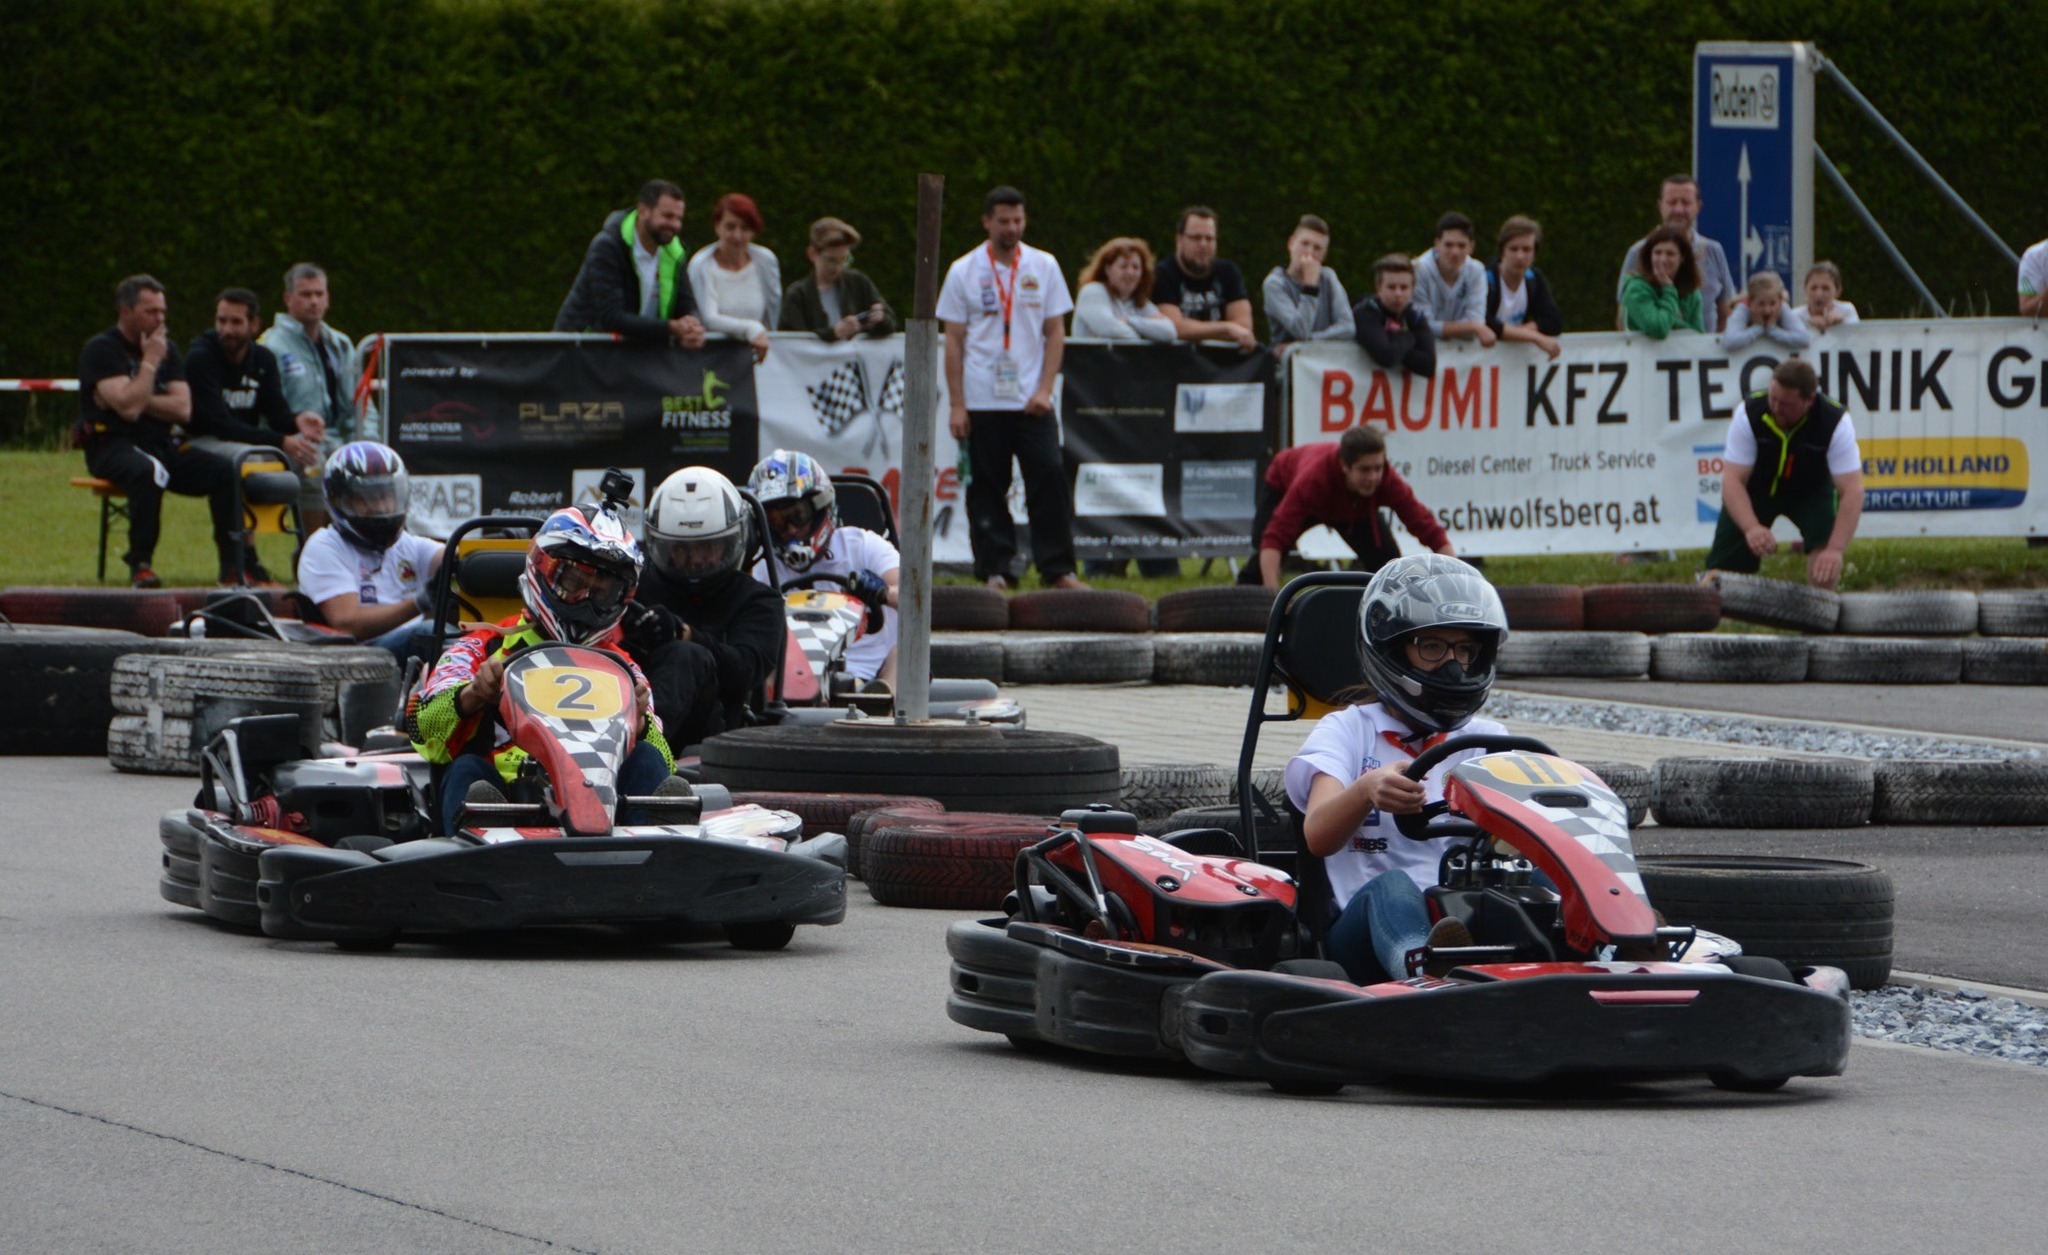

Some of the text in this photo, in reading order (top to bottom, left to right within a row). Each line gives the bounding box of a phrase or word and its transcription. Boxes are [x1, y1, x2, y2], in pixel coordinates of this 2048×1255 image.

[1713, 71, 1757, 118] Ruden
[1320, 366, 1500, 433] BAUMI
[1526, 362, 1629, 427] KFZ
[1987, 346, 2048, 409] G
[519, 401, 625, 421] PLAZA
[661, 396, 702, 411] BEST
[661, 410, 731, 429] FITNESS
[1427, 455, 1476, 475] Diesel
[1480, 454, 1532, 474] Center
[1549, 452, 1592, 471] Truck
[1597, 449, 1657, 470] Service
[1862, 454, 2010, 476] EW HOLLAND
[508, 490, 563, 505] Robert
[1863, 490, 1971, 508] GRICULTURE
[554, 673, 596, 711] 2
[1502, 756, 1568, 784] 11
